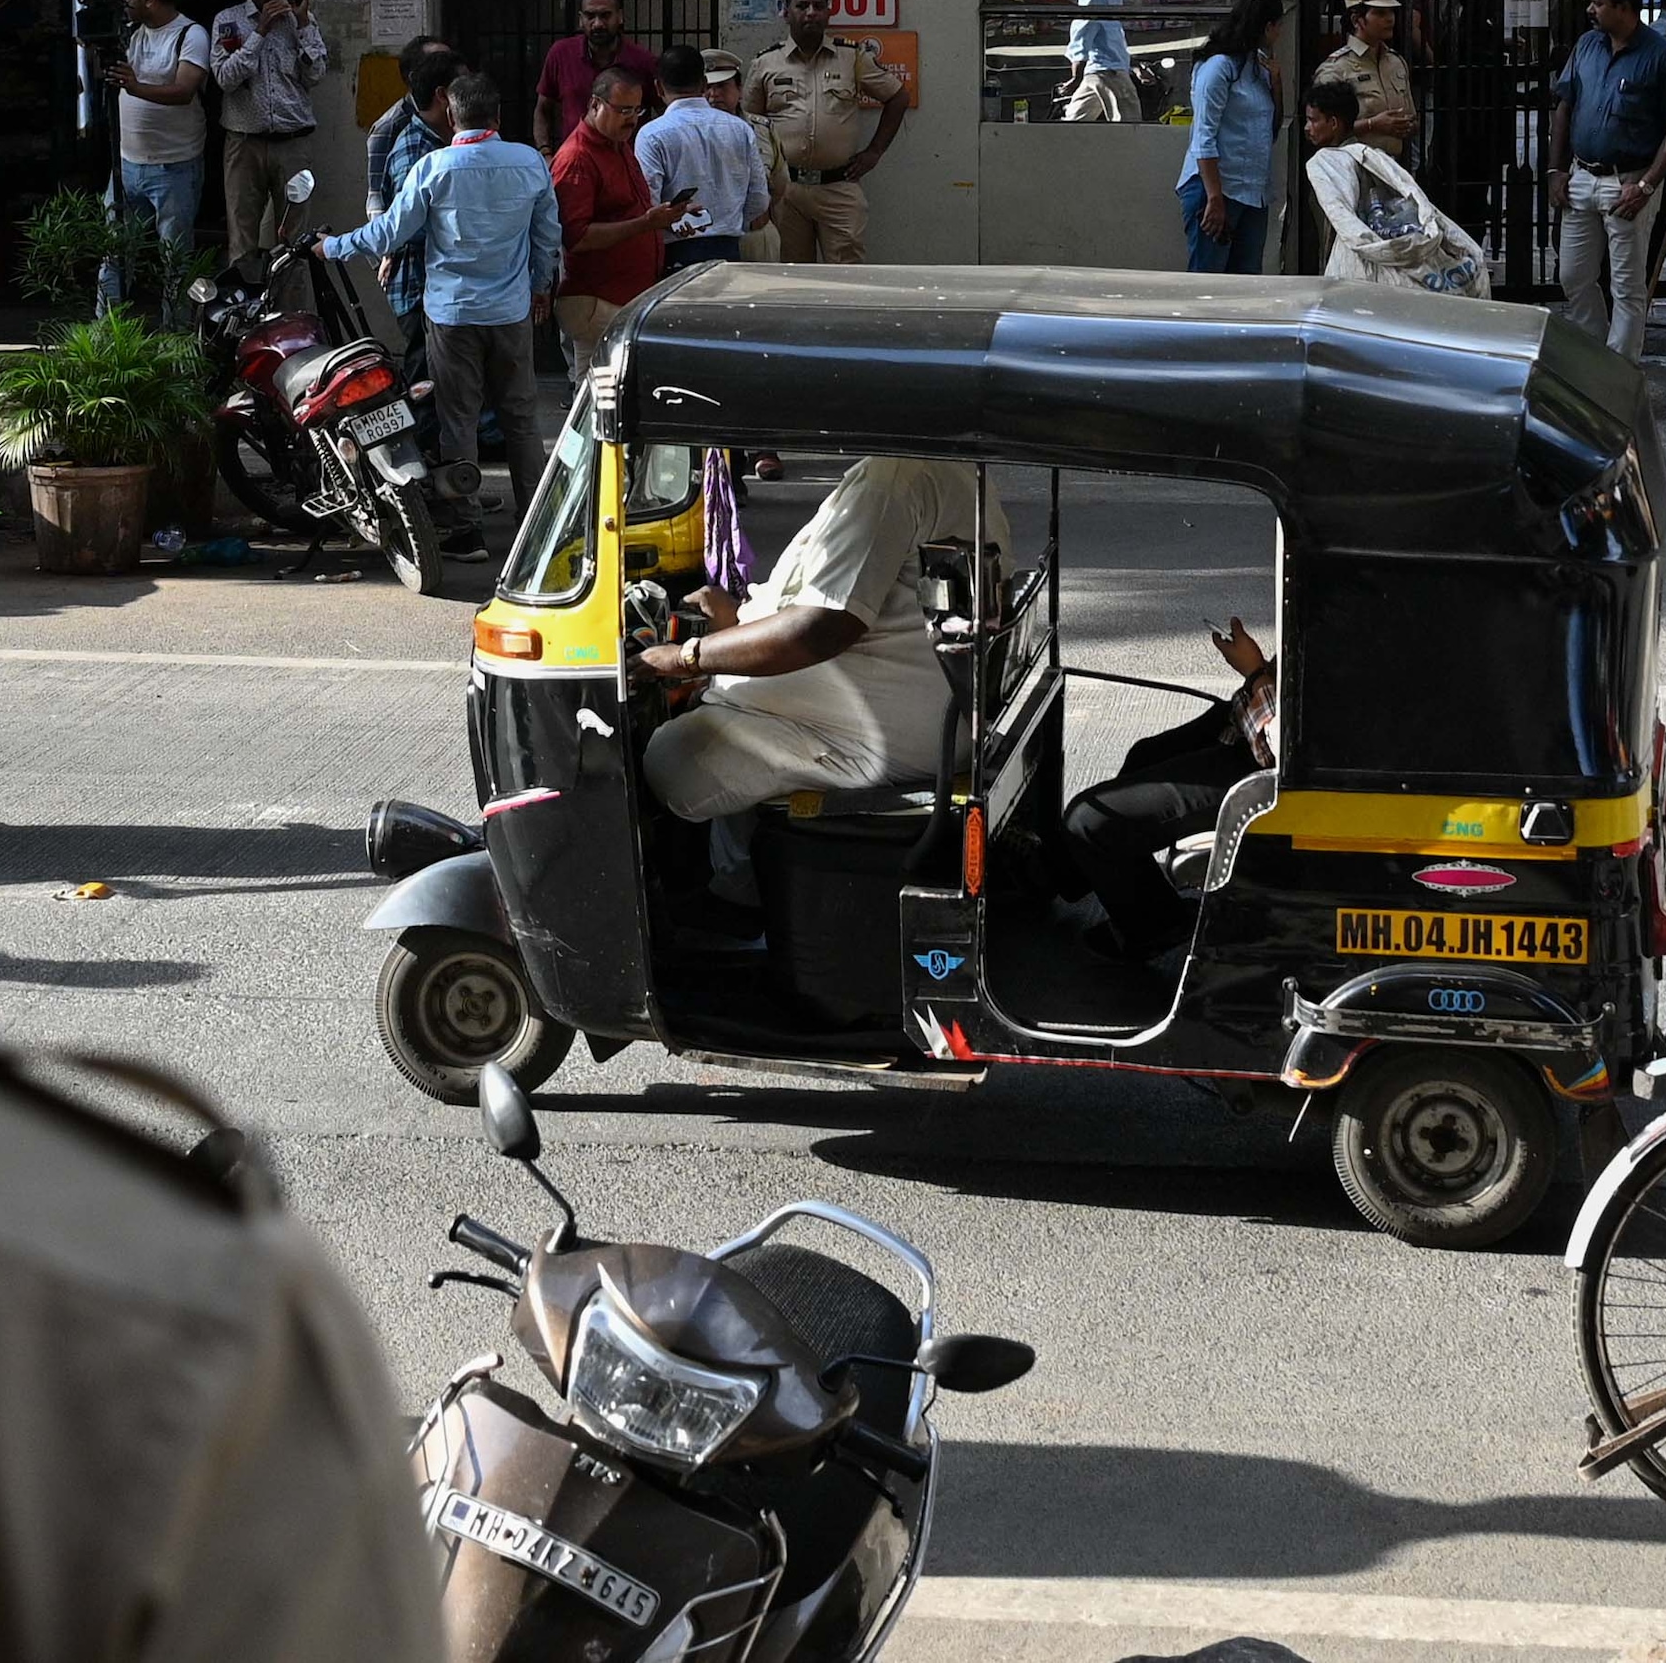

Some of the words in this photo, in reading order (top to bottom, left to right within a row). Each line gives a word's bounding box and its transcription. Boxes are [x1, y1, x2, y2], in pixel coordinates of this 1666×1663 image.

[366, 415, 405, 442] R0997
[564, 644, 600, 661] CNG
[1442, 820, 1484, 838] CNG
[1340, 912, 1583, 960] MH.04.JH.1443
[575, 1452, 621, 1485] TVS
